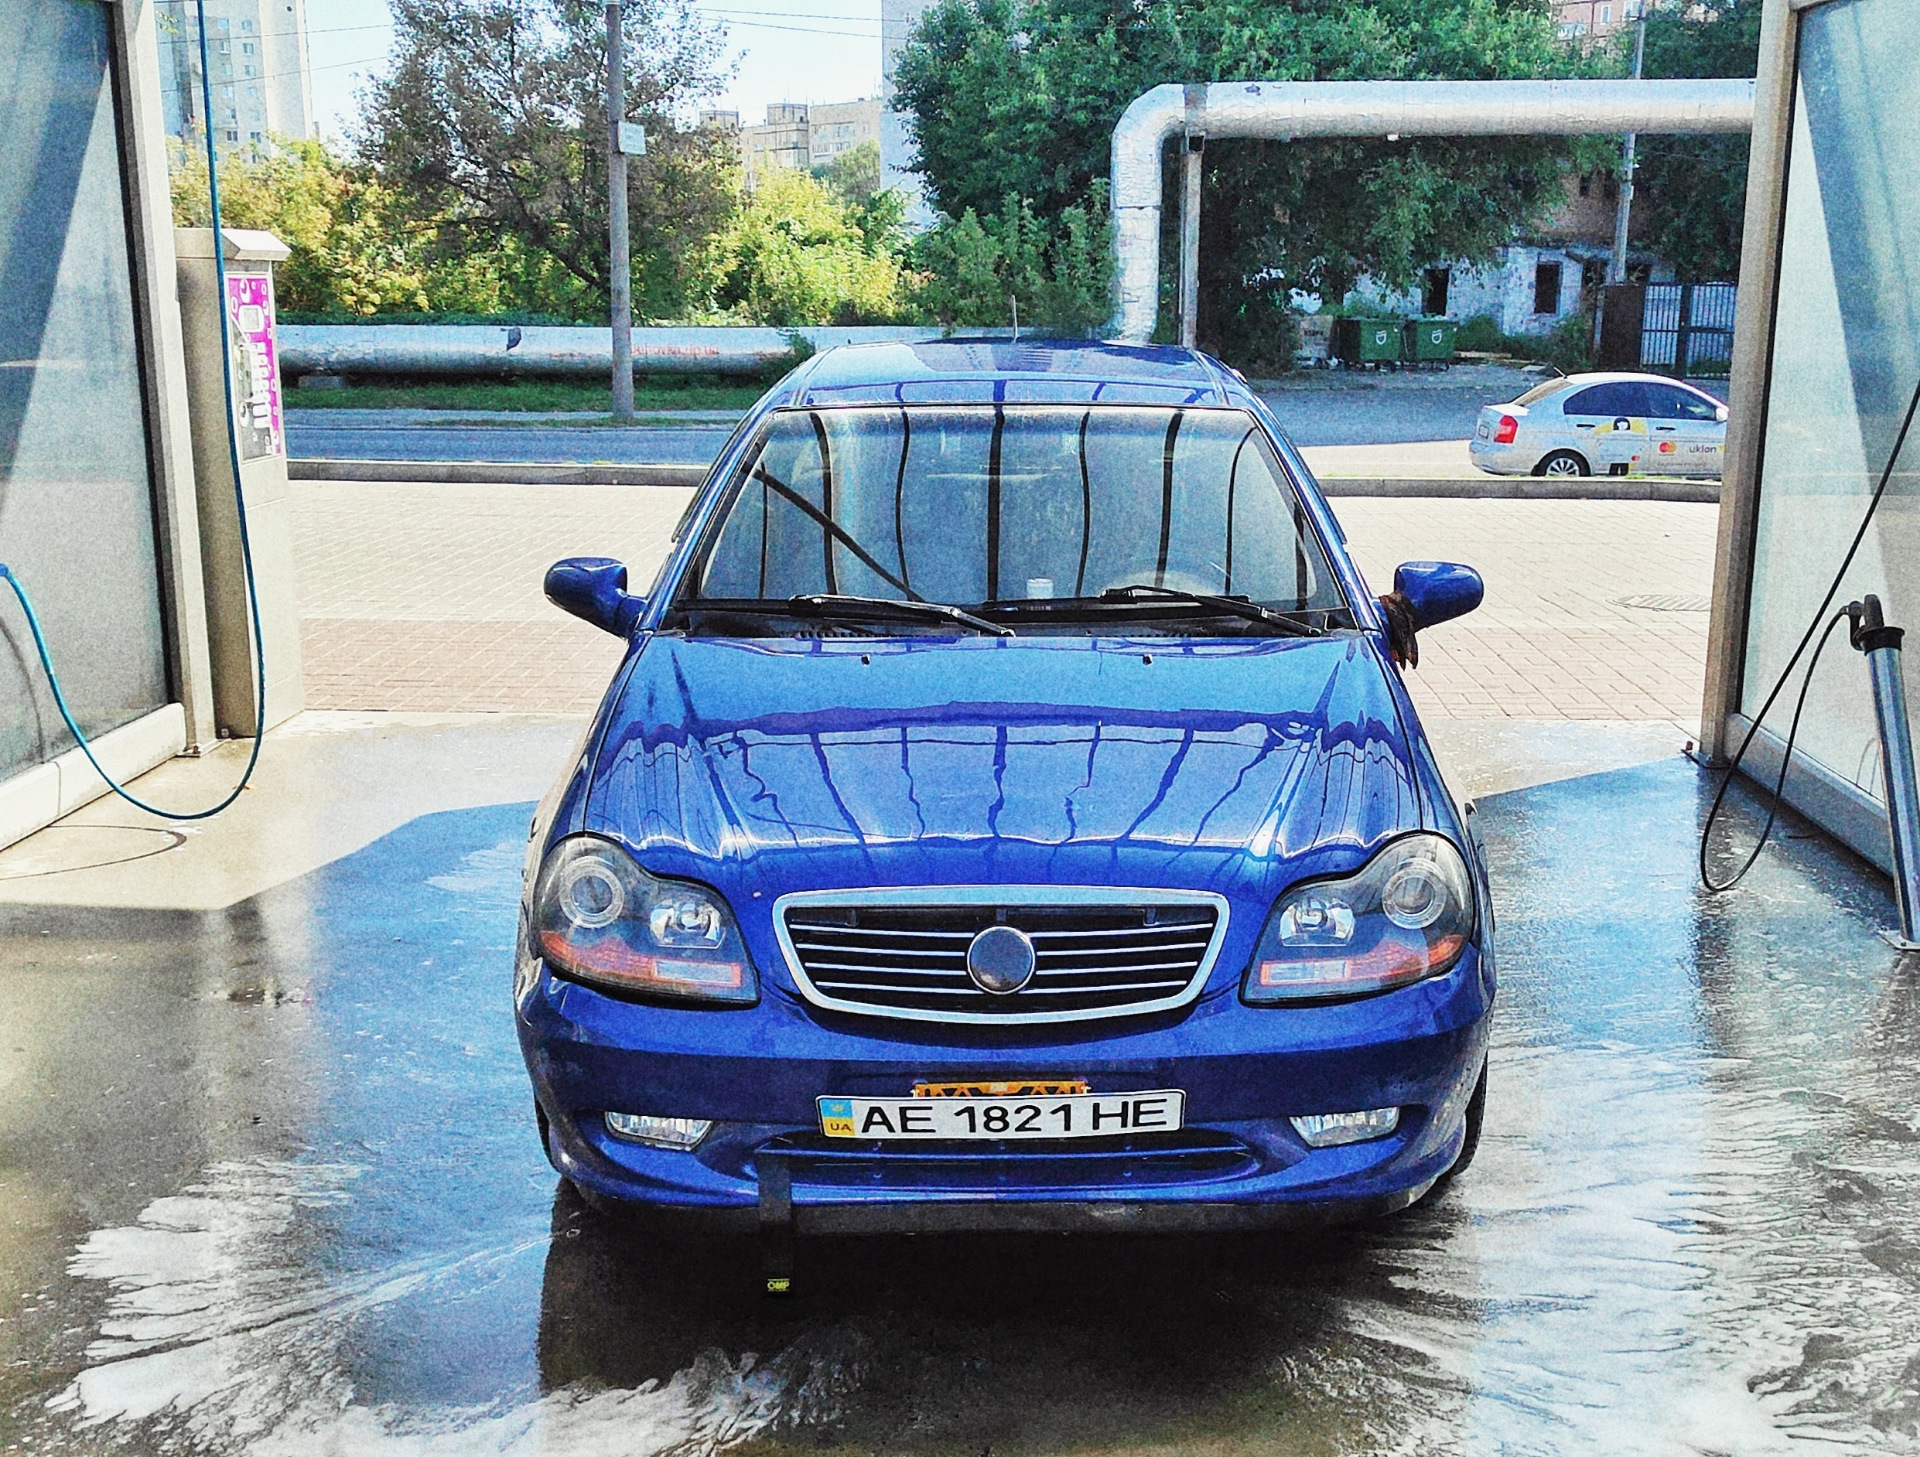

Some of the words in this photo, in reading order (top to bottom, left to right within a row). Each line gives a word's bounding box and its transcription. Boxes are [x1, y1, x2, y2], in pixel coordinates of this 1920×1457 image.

[1689, 444, 1717, 454] uklon
[861, 1105, 936, 1134] AE
[954, 1103, 1072, 1134] 1821
[1092, 1098, 1168, 1131] HE
[829, 1122, 852, 1132] UA
